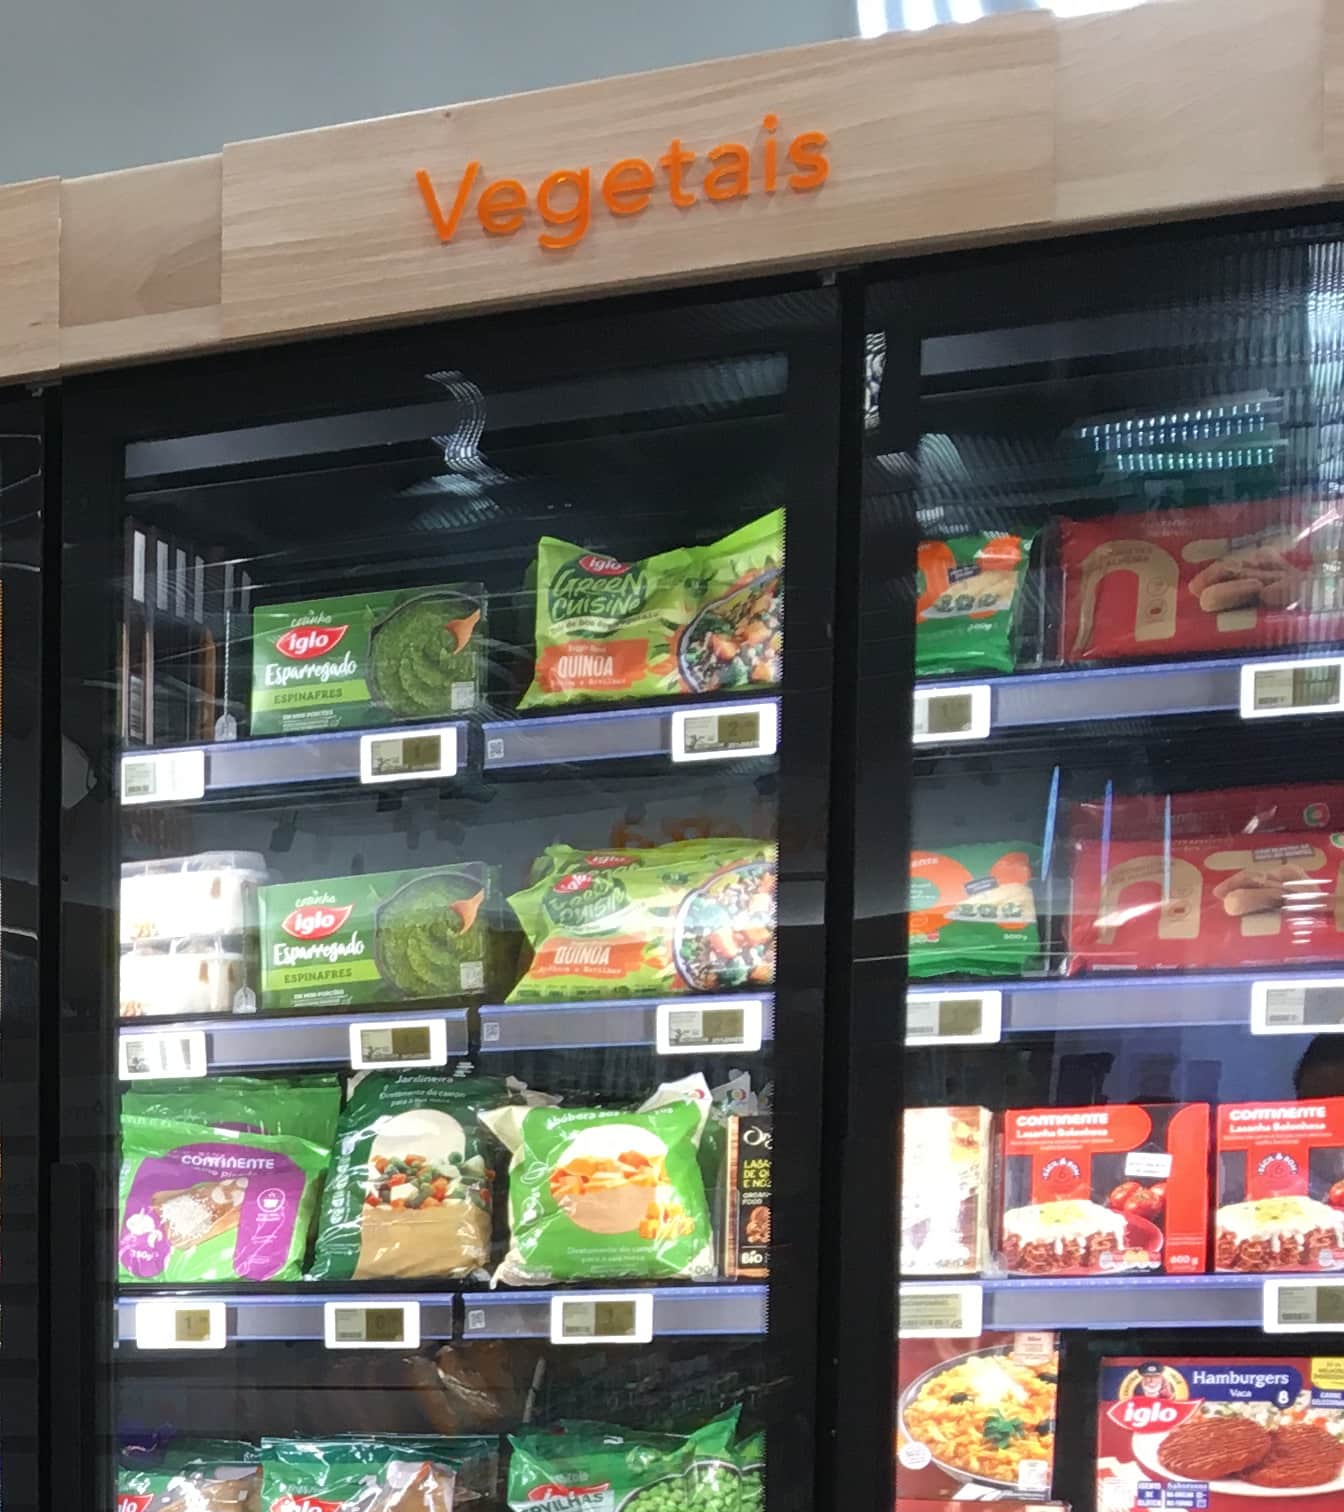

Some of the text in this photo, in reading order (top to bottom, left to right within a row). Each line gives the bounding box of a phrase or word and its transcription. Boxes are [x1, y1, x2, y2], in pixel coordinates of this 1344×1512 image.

[417, 114, 832, 247] Vegetais
[587, 555, 621, 573] iglo
[287, 629, 329, 655] iglo
[265, 659, 358, 687] Esparregado
[558, 656, 614, 678] QUINOA
[274, 687, 343, 705] ESPINAFRES
[291, 908, 333, 934] iglo
[274, 940, 364, 967] Esparregado
[554, 946, 609, 966] QUINOA
[284, 968, 352, 984] ESPINAFRES
[1017, 1113, 1107, 1127] CONTINENTE
[1230, 1106, 1326, 1120] CONTINENTE
[182, 1155, 274, 1171] CONTINENTE
[1193, 1369, 1289, 1388] Hamburgers
[1229, 1388, 1252, 1399] Vaca
[1278, 1390, 1289, 1405] 8
[1124, 1401, 1177, 1426] iglo
